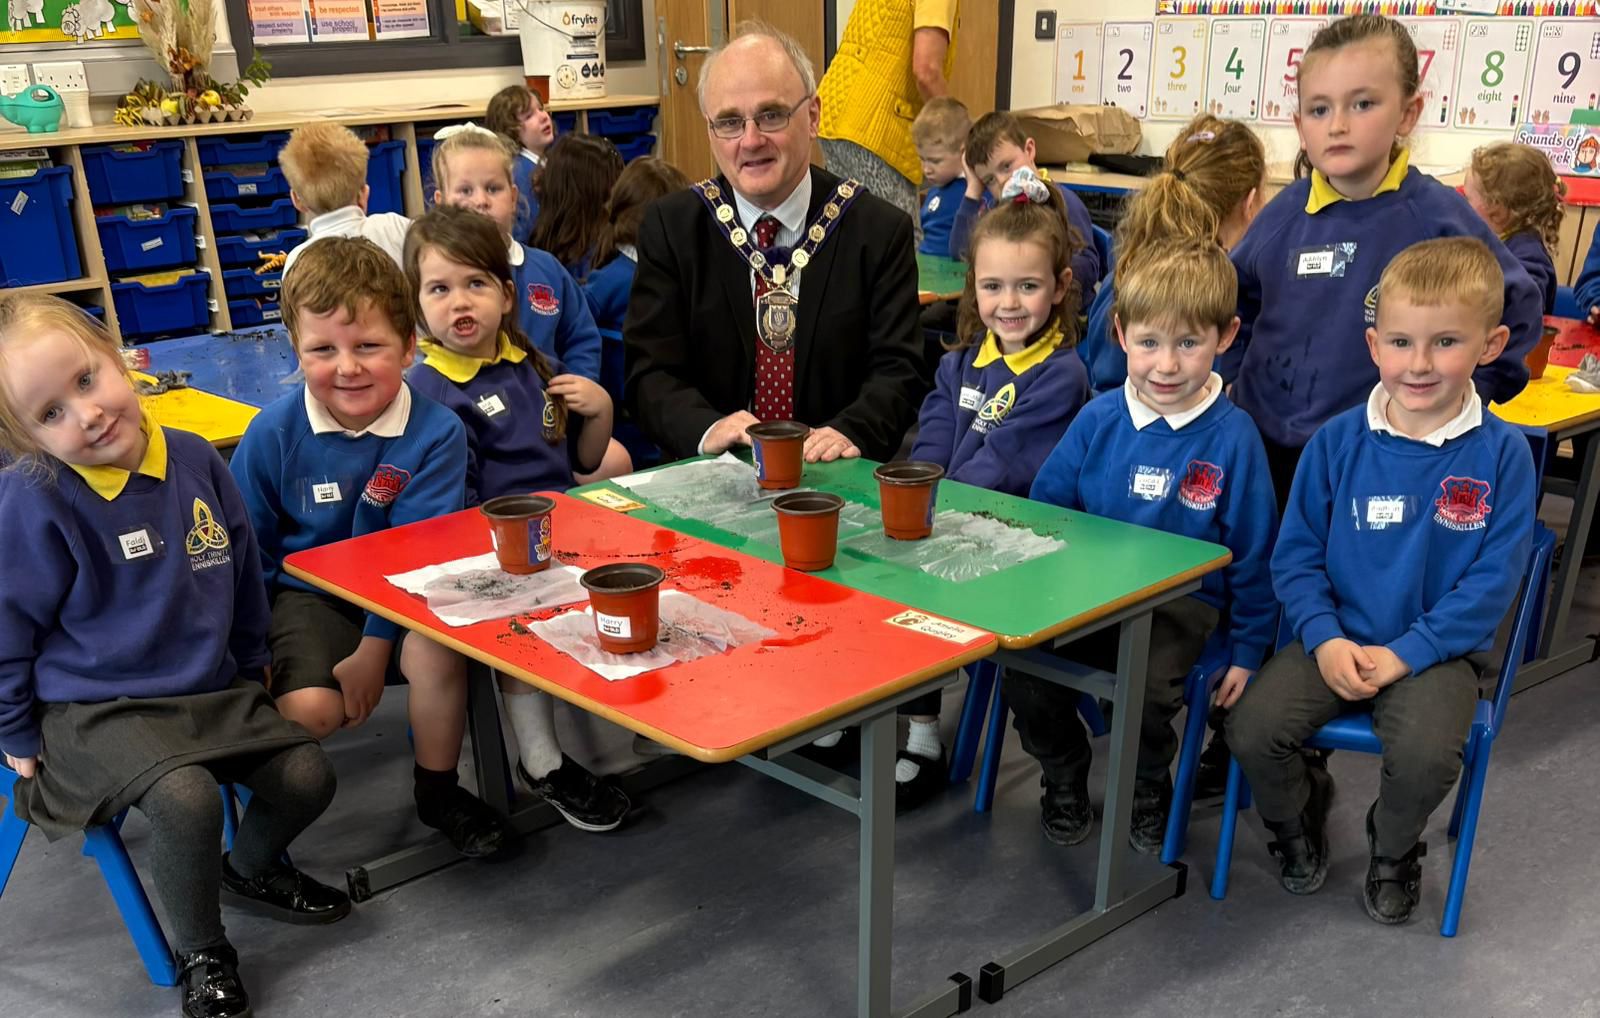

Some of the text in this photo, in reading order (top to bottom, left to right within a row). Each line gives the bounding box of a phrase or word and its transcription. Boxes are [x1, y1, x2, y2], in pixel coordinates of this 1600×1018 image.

[319, 5, 360, 14] be respected
[334, 19, 355, 27] school
[571, 14, 598, 28] frylite
[332, 26, 359, 34] property
[1073, 50, 1086, 81] 1
[1117, 48, 1134, 81] 2
[1169, 46, 1187, 79] 3
[1225, 47, 1245, 80] 4
[1283, 48, 1304, 82] 5
[1481, 50, 1505, 88] 8
[1557, 51, 1582, 90] 9
[1072, 85, 1085, 93] one
[1117, 84, 1132, 93] two
[1168, 82, 1188, 92] three
[1223, 82, 1242, 96] four
[1477, 90, 1502, 103] eight
[1552, 91, 1576, 104] nine
[1519, 131, 1581, 150] Sounds of
[1433, 513, 1486, 531] ENNISKILLEN
[191, 554, 231, 571] ENNISKILLEN
